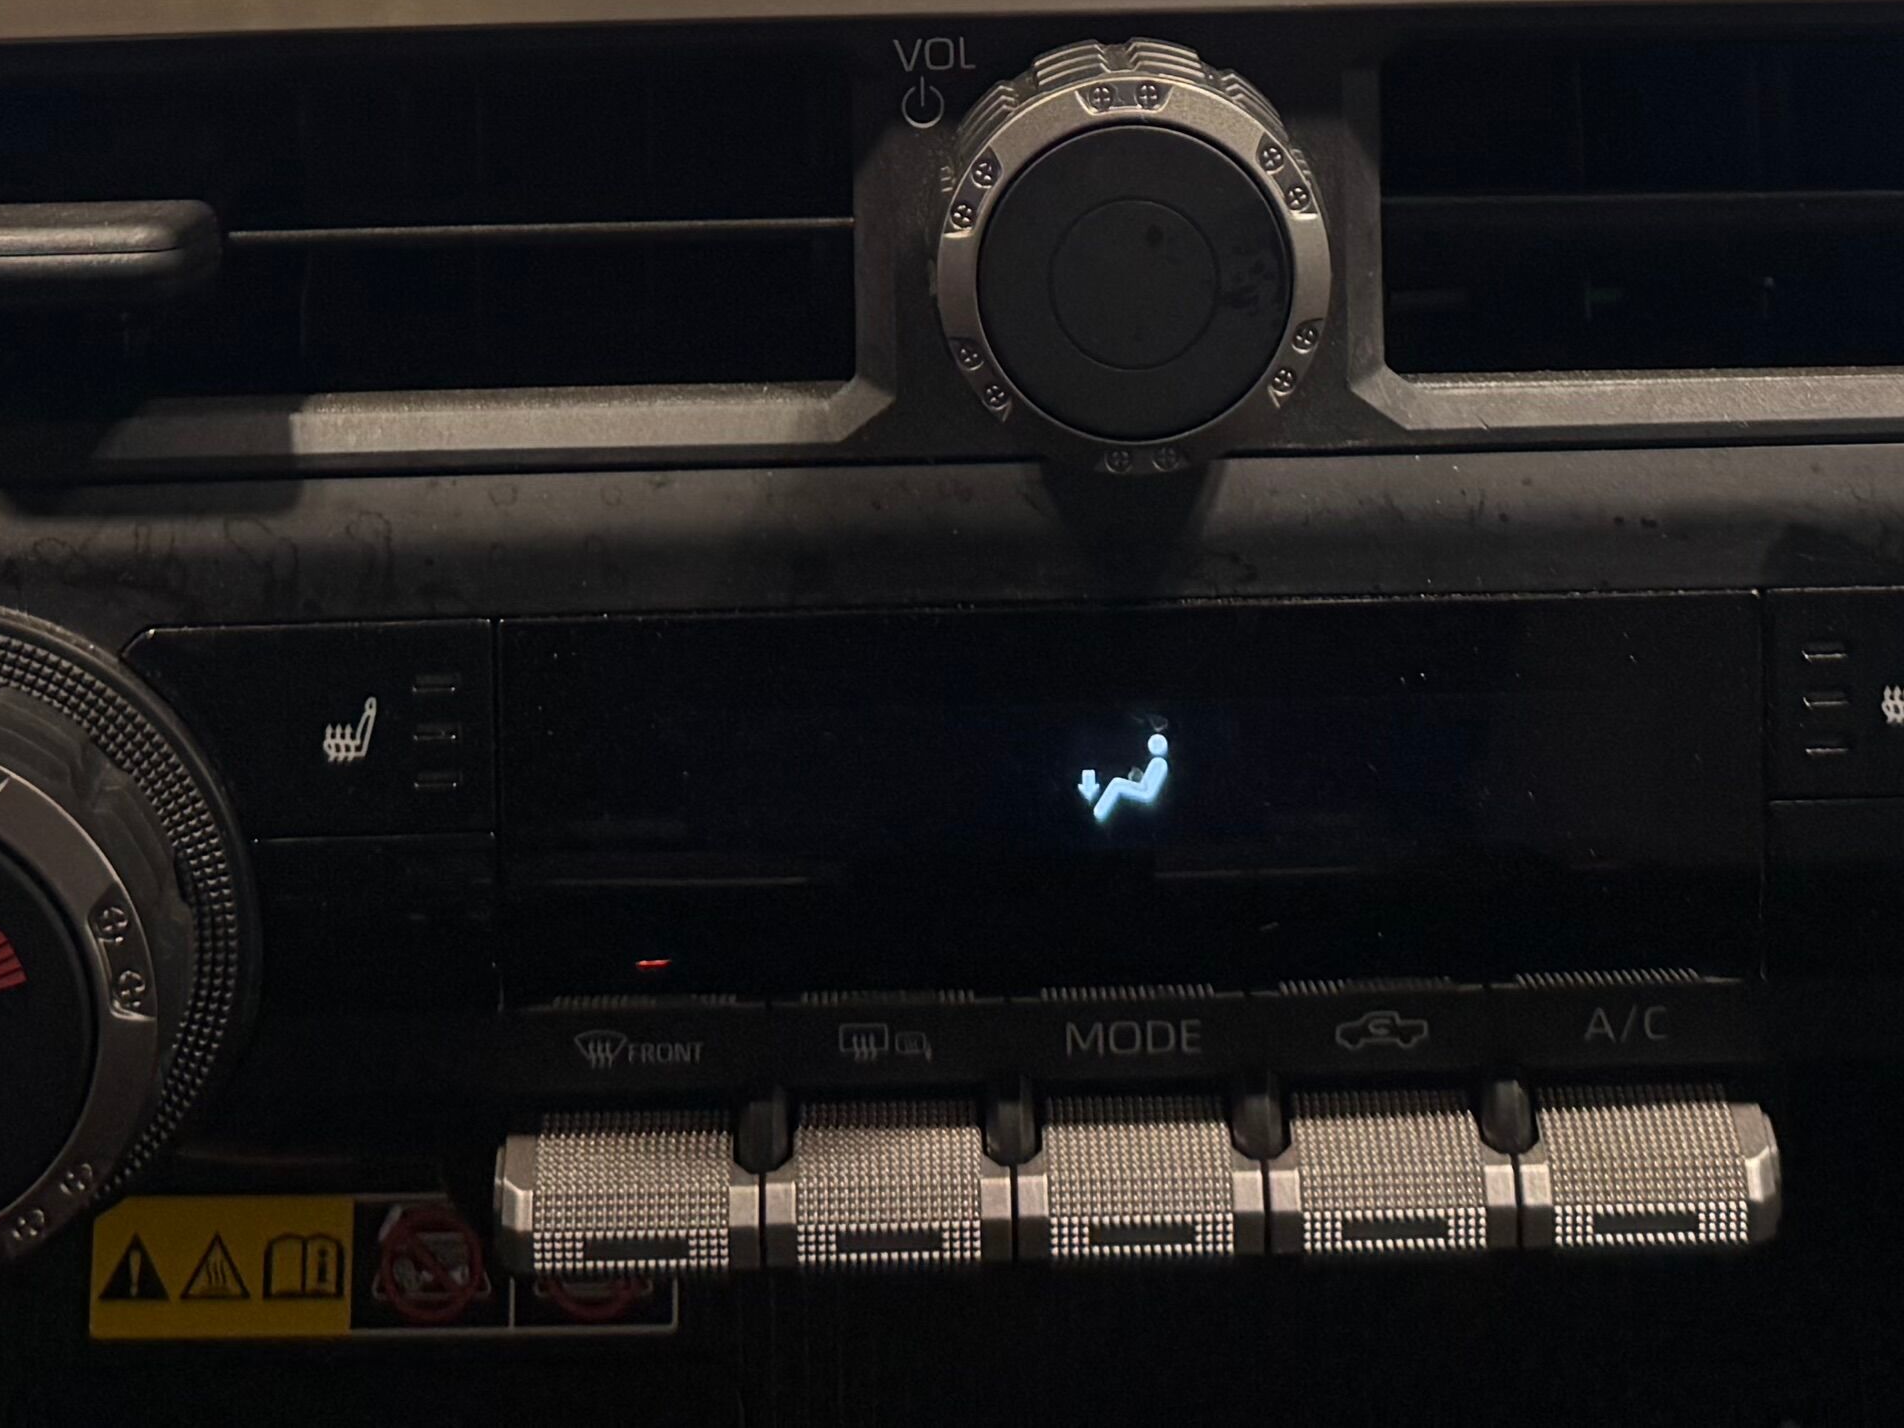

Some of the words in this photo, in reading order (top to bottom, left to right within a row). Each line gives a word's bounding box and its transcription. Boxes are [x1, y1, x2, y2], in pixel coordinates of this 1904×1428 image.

[893, 36, 976, 72] VOL
[1064, 1019, 1202, 1058] MODE
[1583, 1005, 1669, 1043] A/C
[627, 1042, 704, 1065] FRONT
